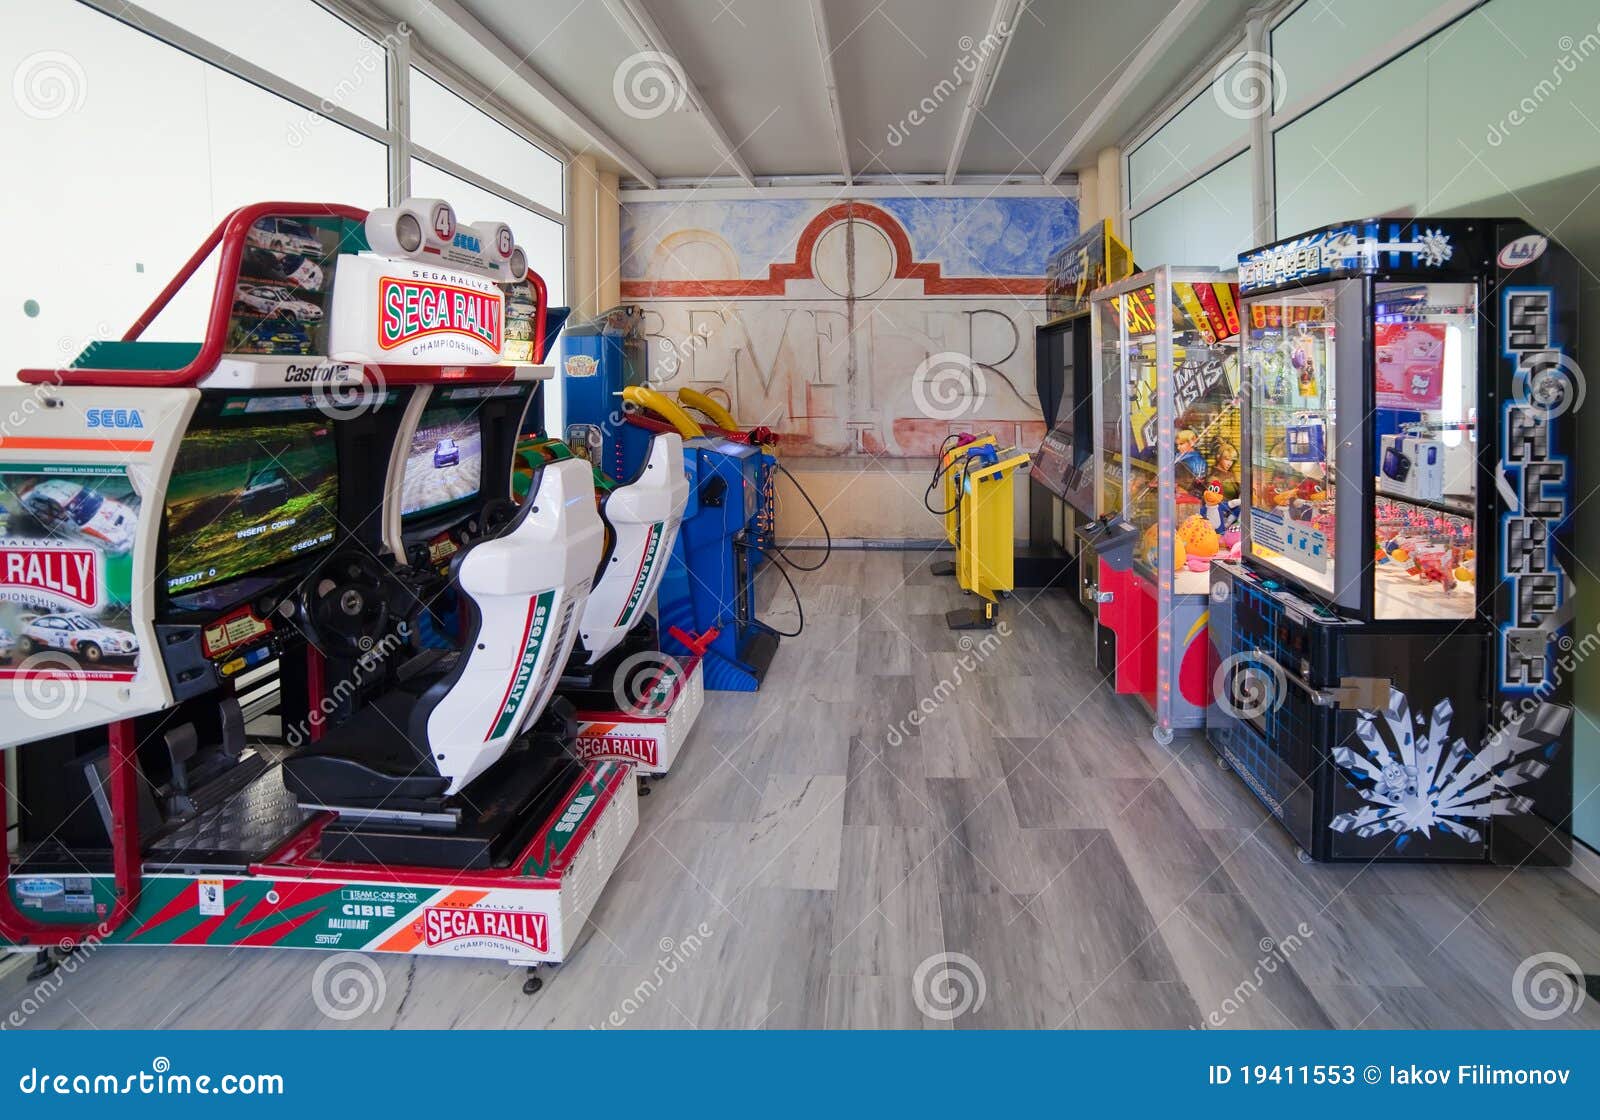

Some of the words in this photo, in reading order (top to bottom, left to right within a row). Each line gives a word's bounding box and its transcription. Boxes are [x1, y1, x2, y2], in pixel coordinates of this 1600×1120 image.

[453, 233, 480, 253] SEGA
[384, 284, 450, 340] SEGA
[454, 292, 500, 346] RALLY
[412, 339, 480, 357] CHAMPIONSHIP
[285, 365, 334, 382] Castrol
[87, 409, 143, 428] SEGA
[237, 525, 267, 539] INSERT
[7, 552, 92, 601] RALLY
[529, 605, 546, 649] SEGA
[511, 653, 535, 701] RALLY
[504, 703, 516, 714] 2
[575, 738, 610, 760] SEGA
[612, 739, 655, 763] RALLY
[555, 795, 596, 832] SEGA
[428, 910, 479, 942] SEGA
[484, 913, 544, 948] RALLY
[454, 941, 521, 954] CHAMPIONSHIP
